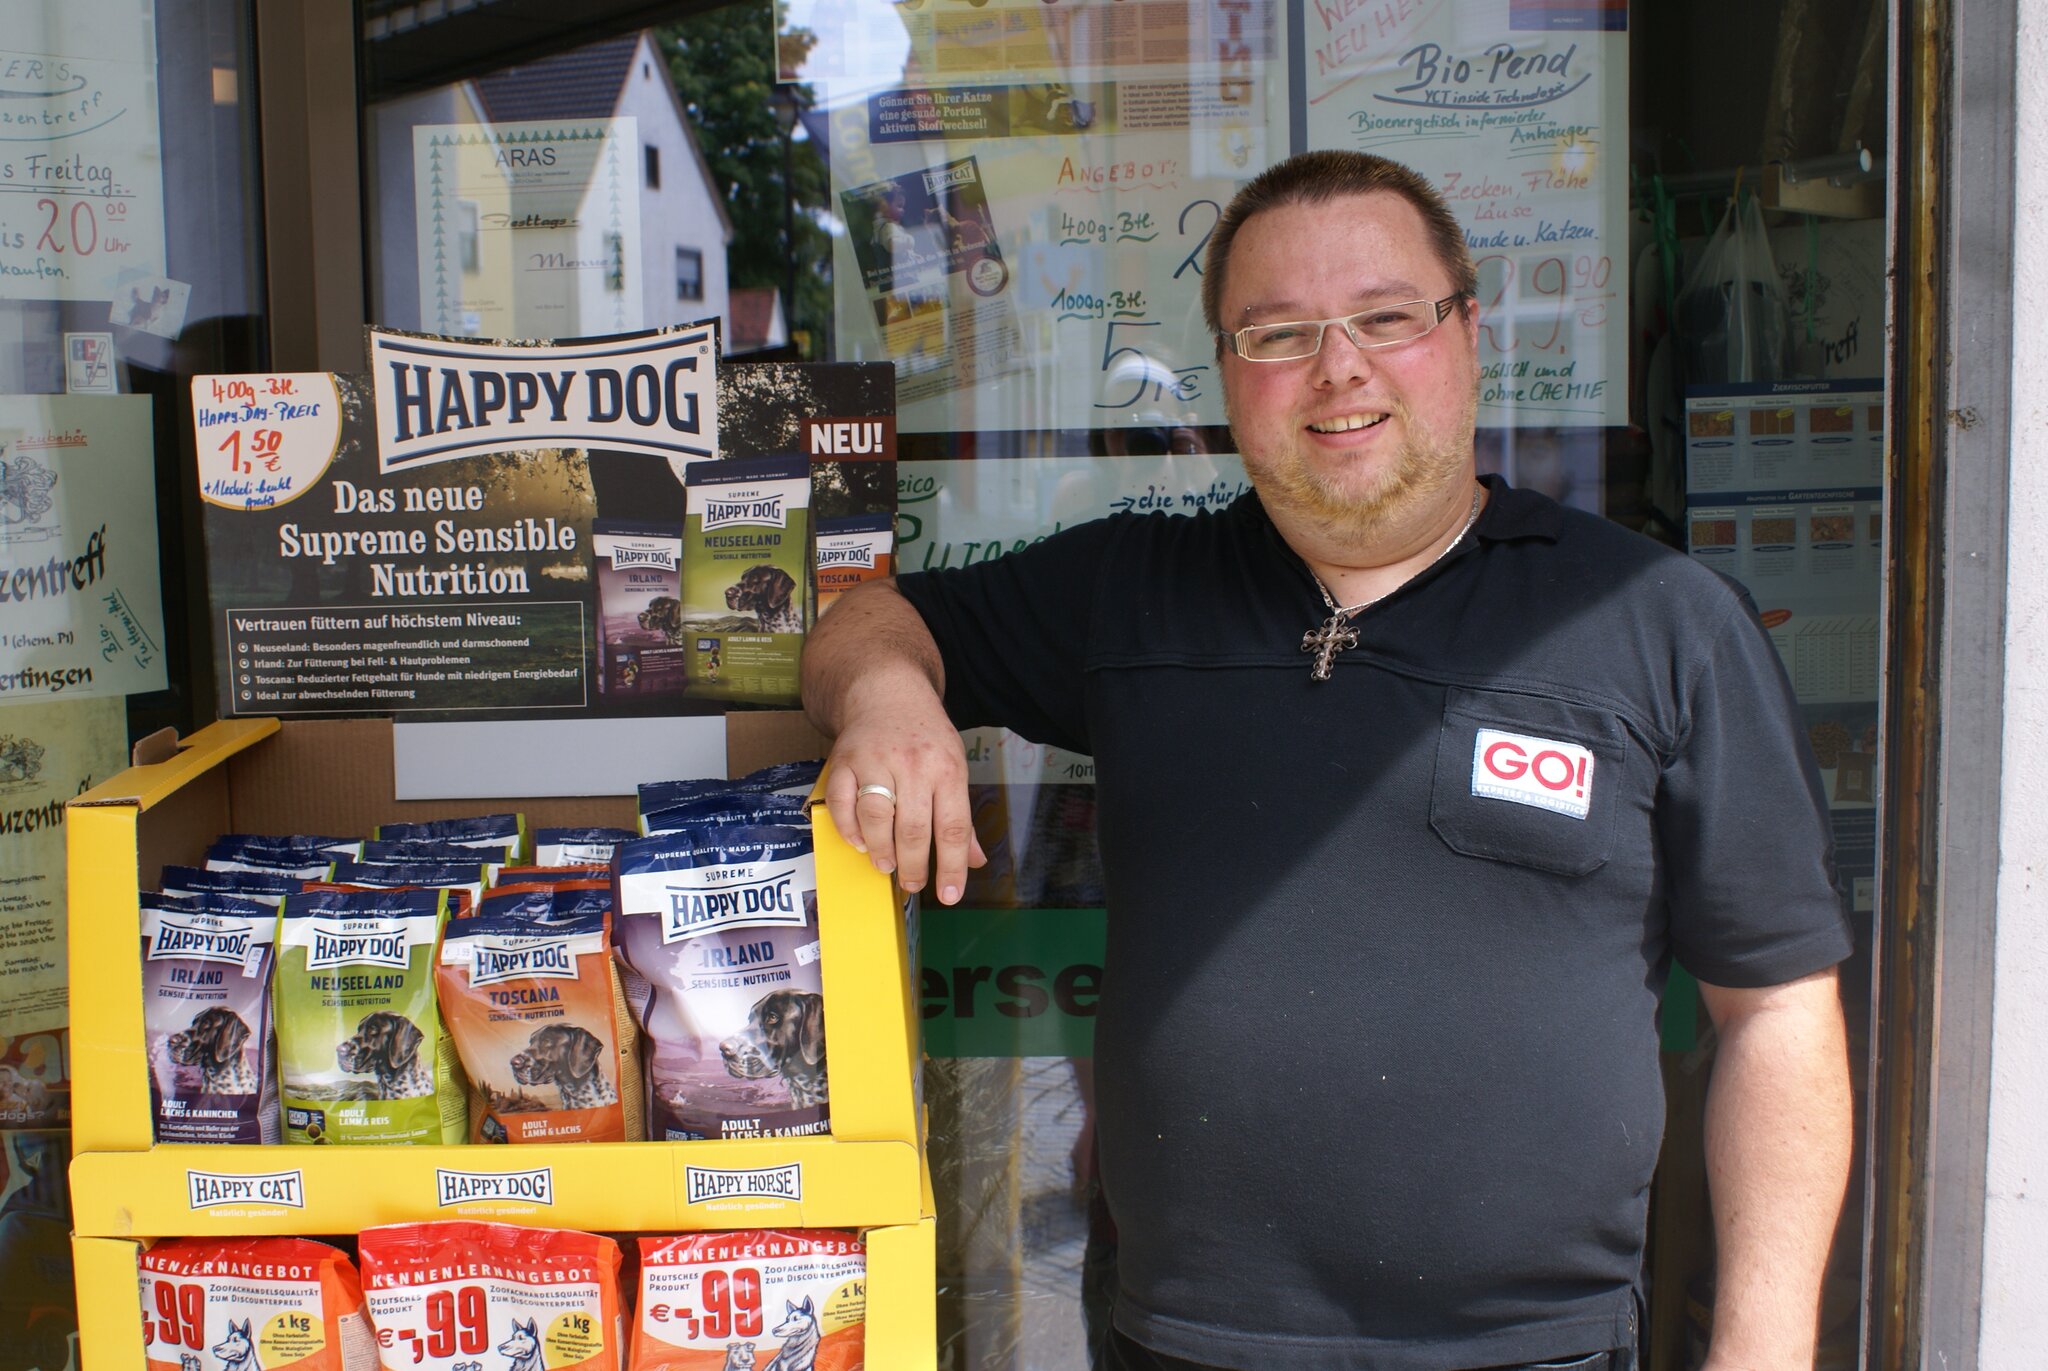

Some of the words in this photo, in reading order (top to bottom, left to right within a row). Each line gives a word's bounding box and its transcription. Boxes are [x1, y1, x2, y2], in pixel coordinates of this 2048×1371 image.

[879, 96, 914, 107] Gönnen
[916, 94, 931, 104] Sie
[935, 93, 961, 104] Ihrer
[963, 92, 993, 103] Katze
[879, 112, 900, 121] eine
[901, 109, 942, 121] gesunde
[943, 108, 981, 117] Portion
[879, 124, 916, 134] aktiven
[918, 118, 987, 131] Stoffwechsel!
[494, 148, 557, 167] ARAS
[24, 153, 112, 198] Freitag
[389, 360, 577, 443] HAPPY
[585, 355, 701, 435] DOG
[810, 422, 884, 456] NEU!
[332, 480, 396, 514] Das
[403, 486, 484, 513] neue
[728, 490, 760, 498] SUPREME
[707, 503, 750, 522] HAPPY
[752, 500, 781, 520] DOG
[279, 523, 427, 566] Supreme
[435, 517, 577, 555] Sensible
[704, 534, 782, 548] NEUSEELAND
[615, 550, 650, 565] HAPPY
[651, 551, 672, 565] DOG
[848, 547, 870, 562] DOG
[370, 563, 530, 597] Nutrition
[629, 574, 663, 583] IRLAND
[820, 574, 862, 584] TOSCANA
[235, 618, 307, 632] Vertrauen
[311, 615, 360, 630] füttern
[364, 614, 389, 629] auf
[391, 613, 462, 629] höchstem
[466, 612, 522, 626] Niveau:
[253, 643, 311, 653] Neuseeland:
[313, 641, 361, 651] Besonders
[363, 638, 440, 652] magenfreundlich
[442, 639, 460, 649] und
[462, 637, 530, 648] darmschonend
[254, 659, 285, 669] Irland:
[287, 659, 303, 668] Zur
[304, 657, 349, 669] Fütterung
[351, 657, 366, 667] bei
[367, 657, 388, 667] Fell-
[389, 657, 397, 666] &
[400, 655, 471, 667] Hautproblemen
[255, 675, 295, 684] Toscana:
[297, 673, 350, 683] Reduzierter
[352, 672, 399, 684] Fettgehalt
[400, 671, 413, 681] für
[415, 670, 446, 681] Hunde
[447, 669, 463, 680] mit
[464, 669, 511, 682] niedrigem
[513, 667, 578, 681] Energiebedarf
[256, 691, 280, 700] Ideal
[282, 692, 297, 700] zur
[299, 689, 369, 700] abwechselnden
[371, 687, 416, 699] Fütterung
[1483, 741, 1587, 799] GO!
[1476, 784, 1523, 799] EXPRESS
[1535, 794, 1586, 815] LOGISTICS
[654, 851, 691, 860] SUPREME
[764, 840, 803, 850] GERMANY
[705, 868, 755, 882] SUPREME
[670, 891, 741, 929] HAPPY
[743, 879, 795, 914] DOG
[343, 922, 381, 931] SUPREME
[157, 926, 217, 951] HAPPY
[216, 933, 251, 955] DOG
[314, 934, 367, 961] HAPPY
[369, 934, 405, 959] DOG
[476, 950, 532, 977] HAPPY
[532, 943, 570, 969] DOG
[702, 939, 776, 969] IRLAND
[170, 968, 224, 985] IRLAND
[311, 974, 404, 990] NEUSEELAND
[691, 977, 741, 989] SENSIBLE
[743, 970, 792, 986] NUTRITION
[195, 991, 228, 1000] NUTRITION
[356, 997, 391, 1006] NUTRITION
[489, 986, 560, 1006] TOSCANA
[525, 1009, 565, 1020] NUTRITION
[162, 1101, 187, 1109] ADULT
[160, 1108, 185, 1118] LACHS
[192, 1110, 239, 1119] KANINCHEN
[339, 1109, 366, 1118] ADULT
[339, 1117, 362, 1126] LAMM
[371, 1117, 390, 1126] REIS
[522, 1120, 548, 1130] ADULT
[522, 1128, 547, 1139] LAMM
[555, 1125, 582, 1136] LACHS
[721, 1118, 761, 1132] ADULT
[194, 1177, 254, 1203] HAPPY
[259, 1177, 297, 1201] CAT
[443, 1175, 503, 1200] HAPPY
[506, 1173, 546, 1198] DOG
[693, 1171, 743, 1198] HAPPY
[747, 1169, 794, 1195] HORSE
[371, 1262, 592, 1288] KENNENLERNANGEBOT
[649, 1271, 699, 1282] DEUTSCHES
[649, 1282, 690, 1291] PRODUKT
[371, 1305, 413, 1315] PRODUKT
[277, 1317, 286, 1329] 1
[290, 1314, 311, 1331] kg
[562, 1317, 570, 1328] 1
[573, 1314, 590, 1333] kg
